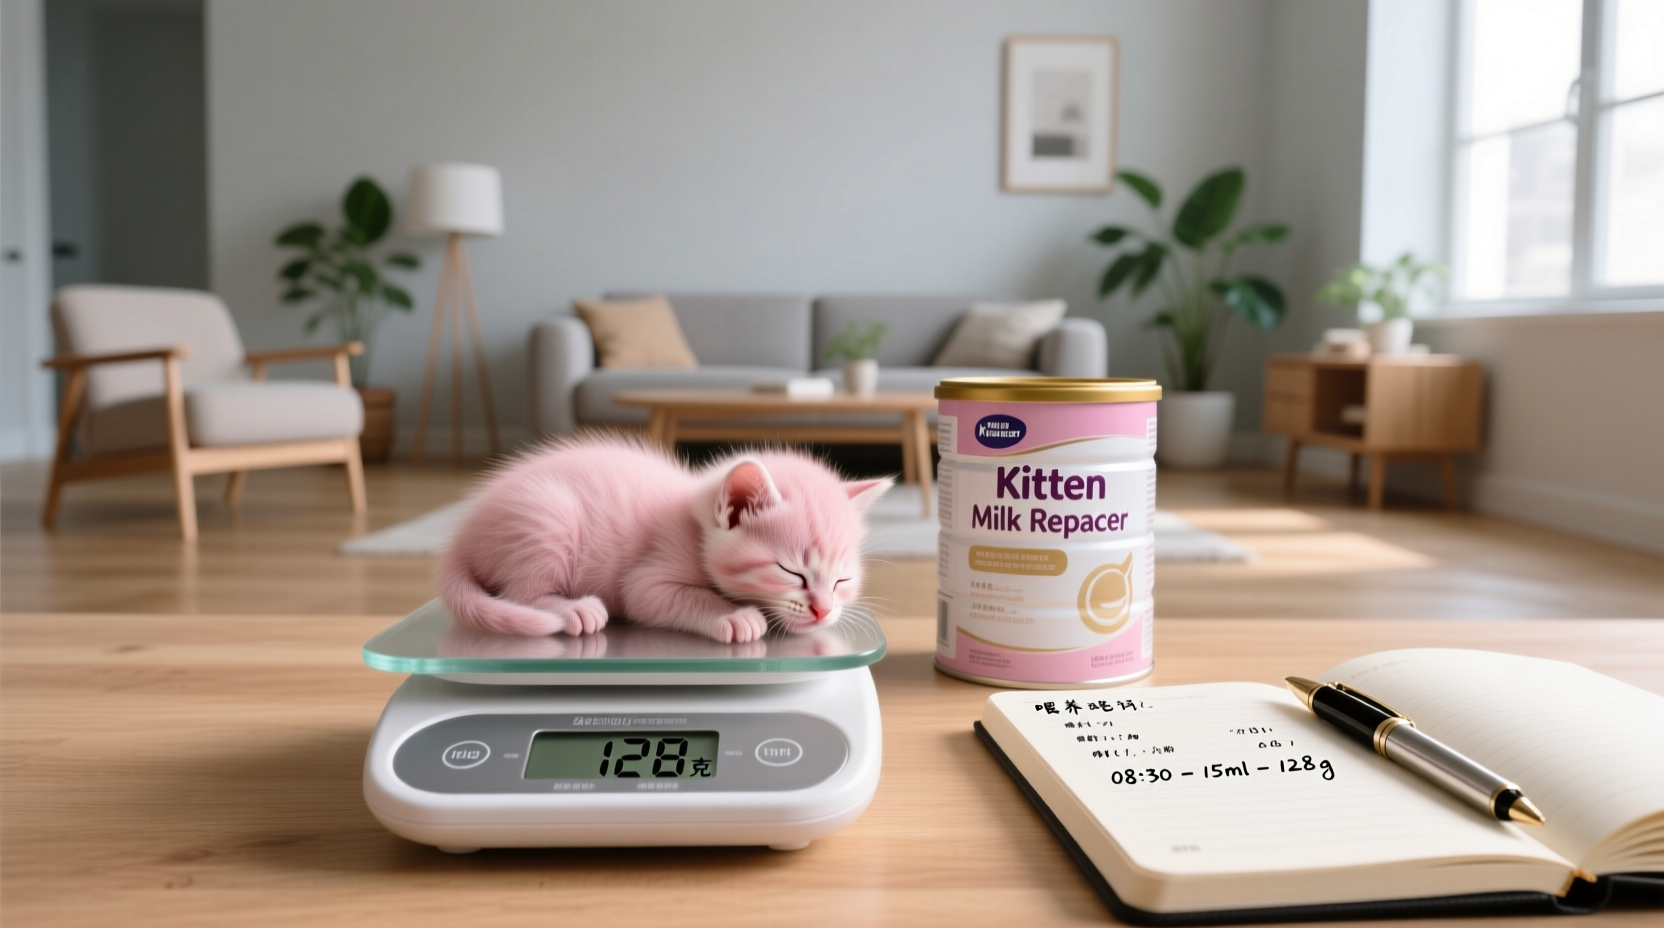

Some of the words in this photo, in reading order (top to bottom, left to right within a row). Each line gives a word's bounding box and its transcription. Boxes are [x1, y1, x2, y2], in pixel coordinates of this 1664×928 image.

[997, 465, 1105, 500] Kitten
[972, 504, 1021, 531] Milk
[1030, 508, 1128, 539] Repacer
[599, 738, 689, 777] 128
[1111, 768, 1173, 785] 08:30
[1203, 760, 1250, 779] 15ml
[1279, 754, 1335, 781] 128g
